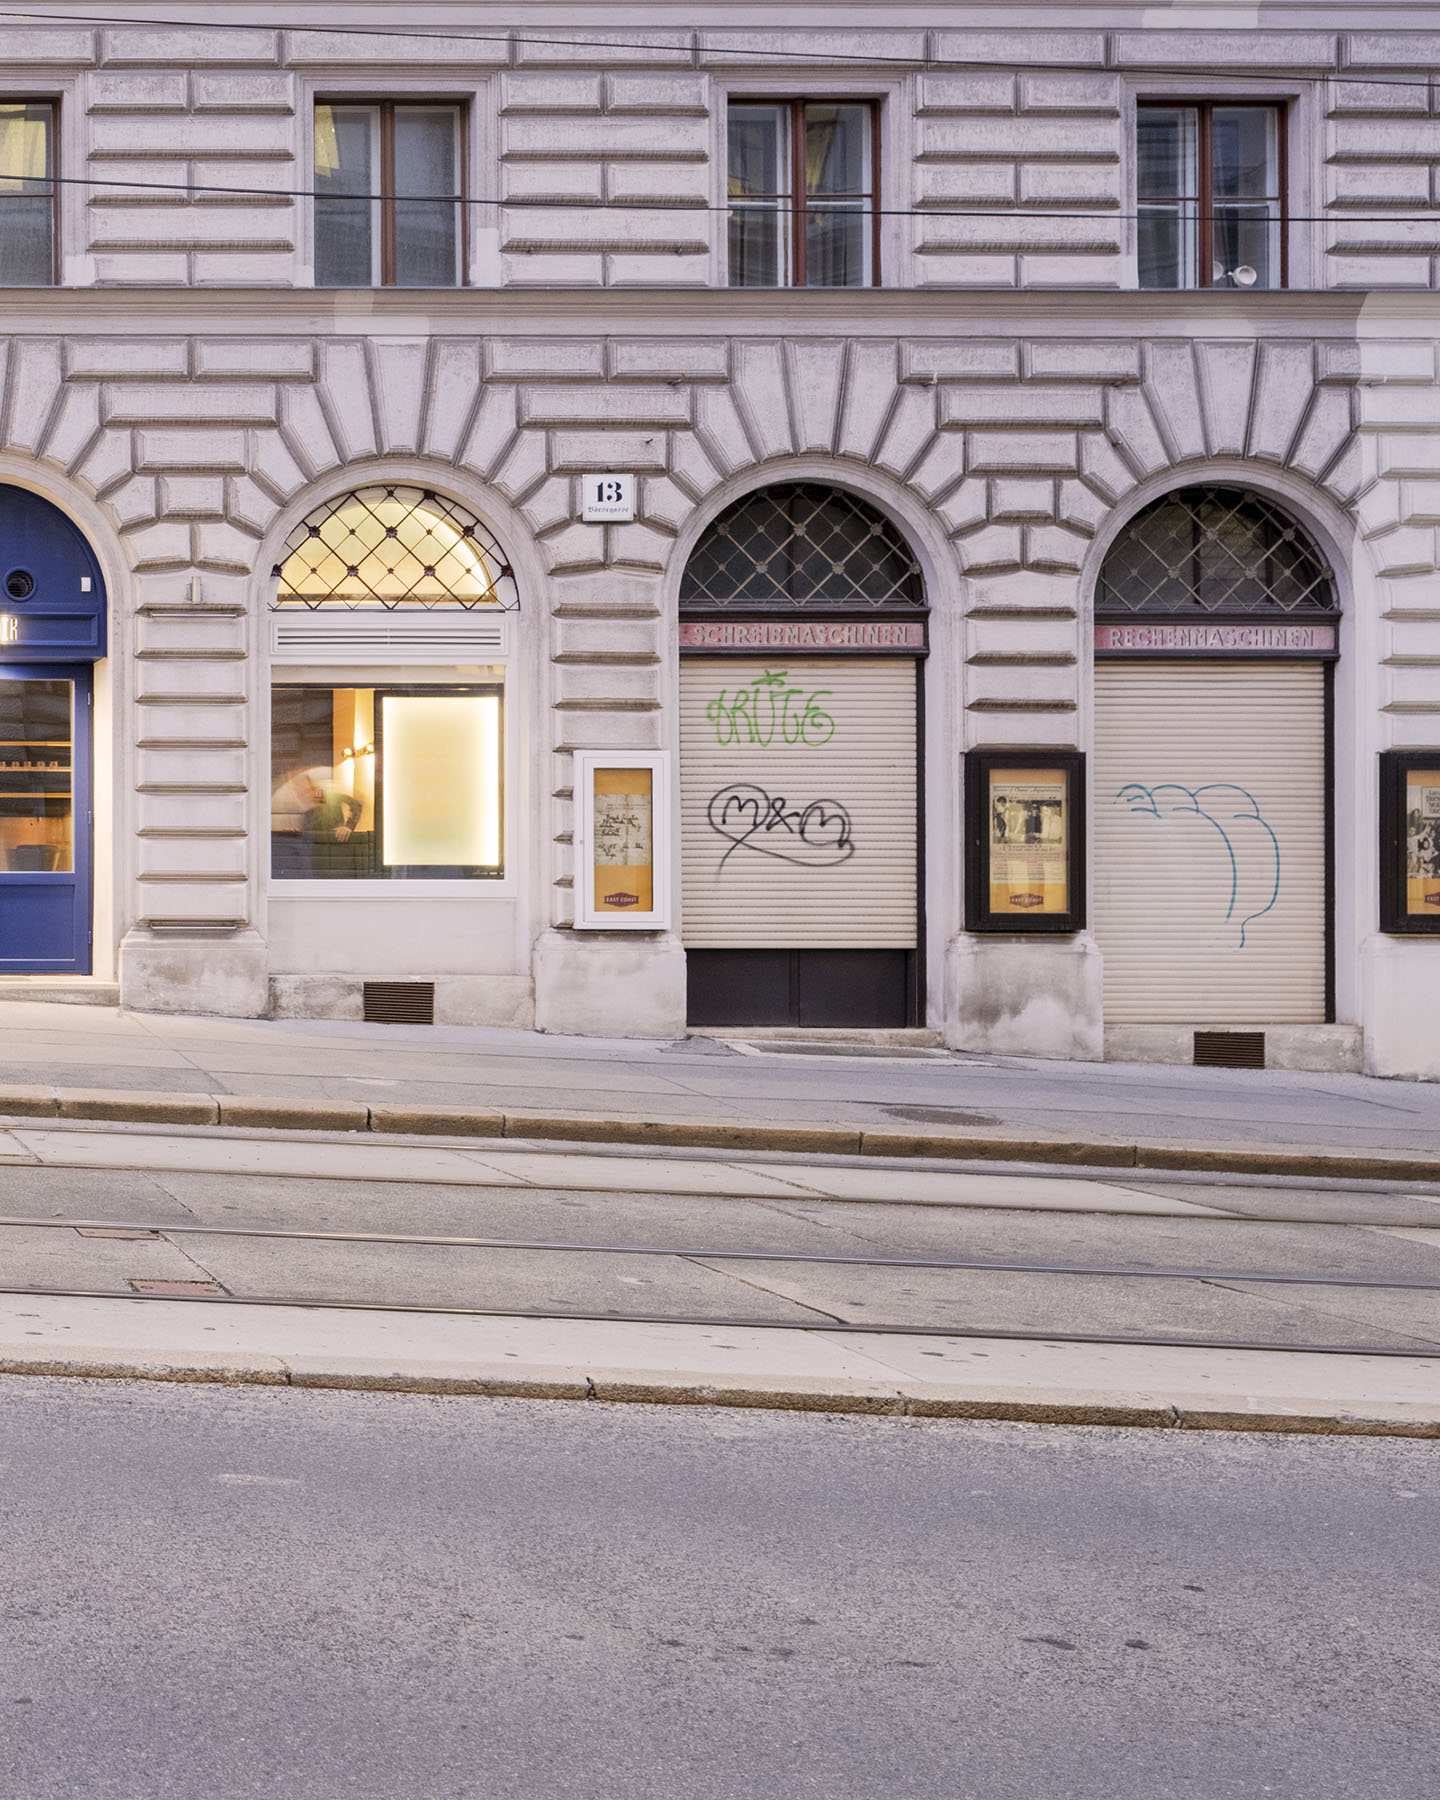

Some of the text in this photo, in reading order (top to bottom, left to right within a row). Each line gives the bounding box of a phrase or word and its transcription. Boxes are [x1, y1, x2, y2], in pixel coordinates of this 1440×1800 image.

[596, 481, 623, 502] 13
[693, 625, 908, 645] SCHREIBMASCHINEN
[1111, 628, 1315, 647] RECHENMASCHINEN
